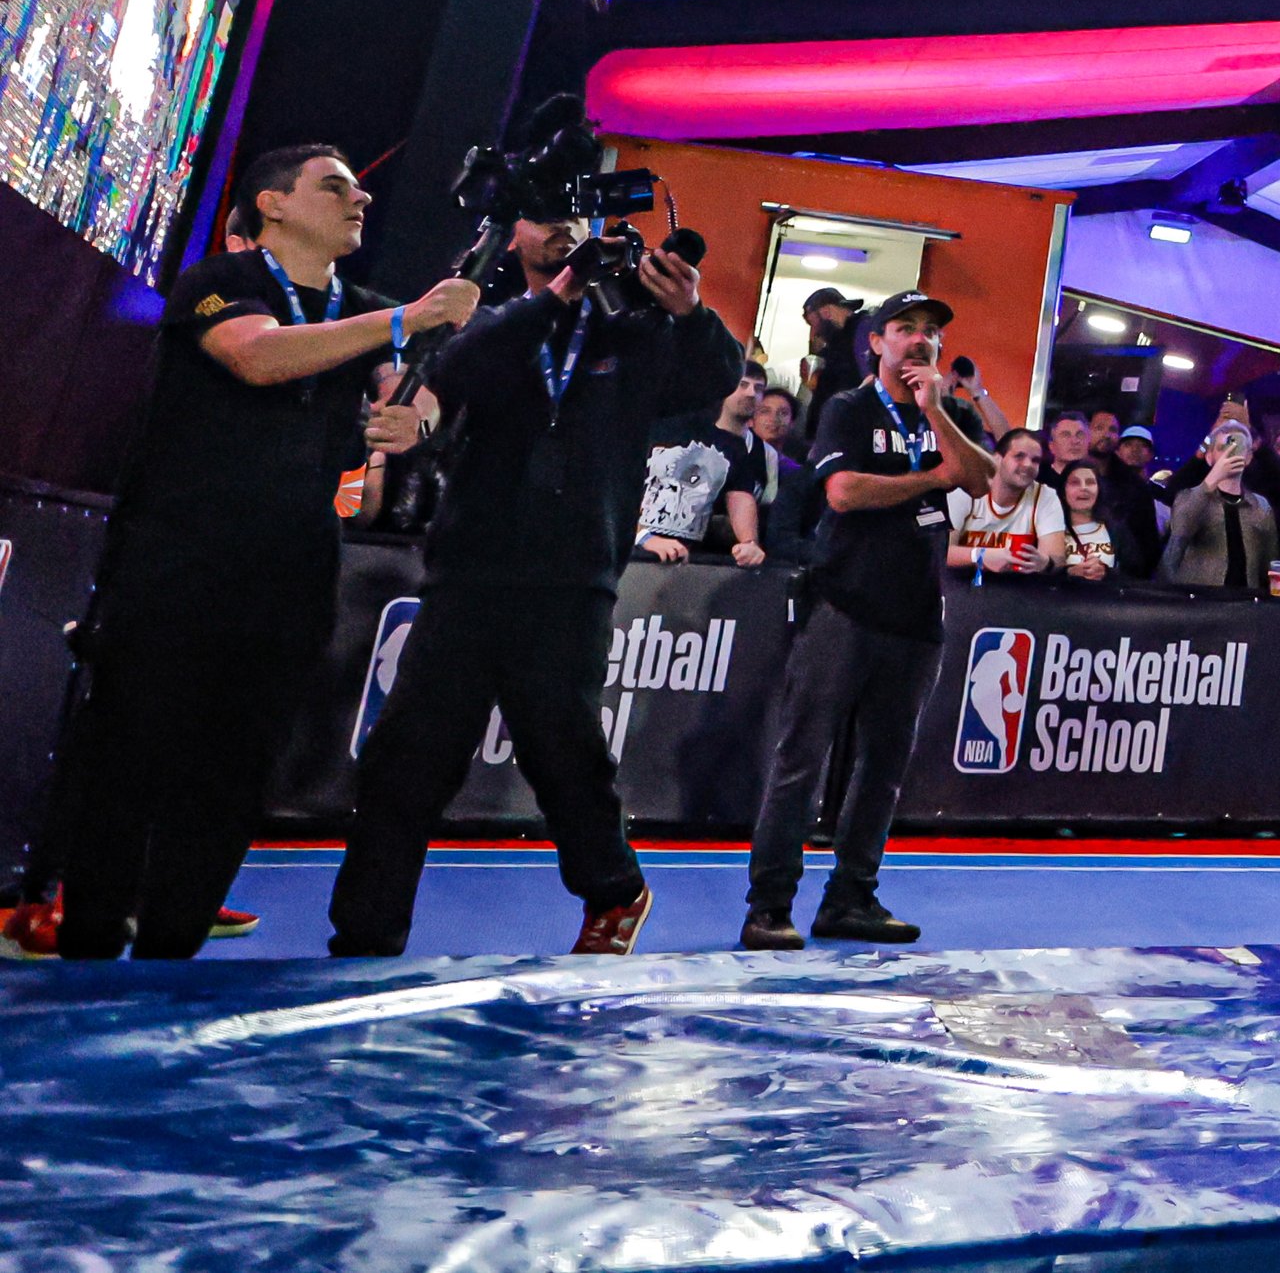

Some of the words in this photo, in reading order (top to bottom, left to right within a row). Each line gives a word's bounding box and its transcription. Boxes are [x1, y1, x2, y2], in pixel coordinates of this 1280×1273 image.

[1040, 633, 1247, 706] Basketball
[963, 739, 994, 763] NBA
[1029, 704, 1170, 773] School
